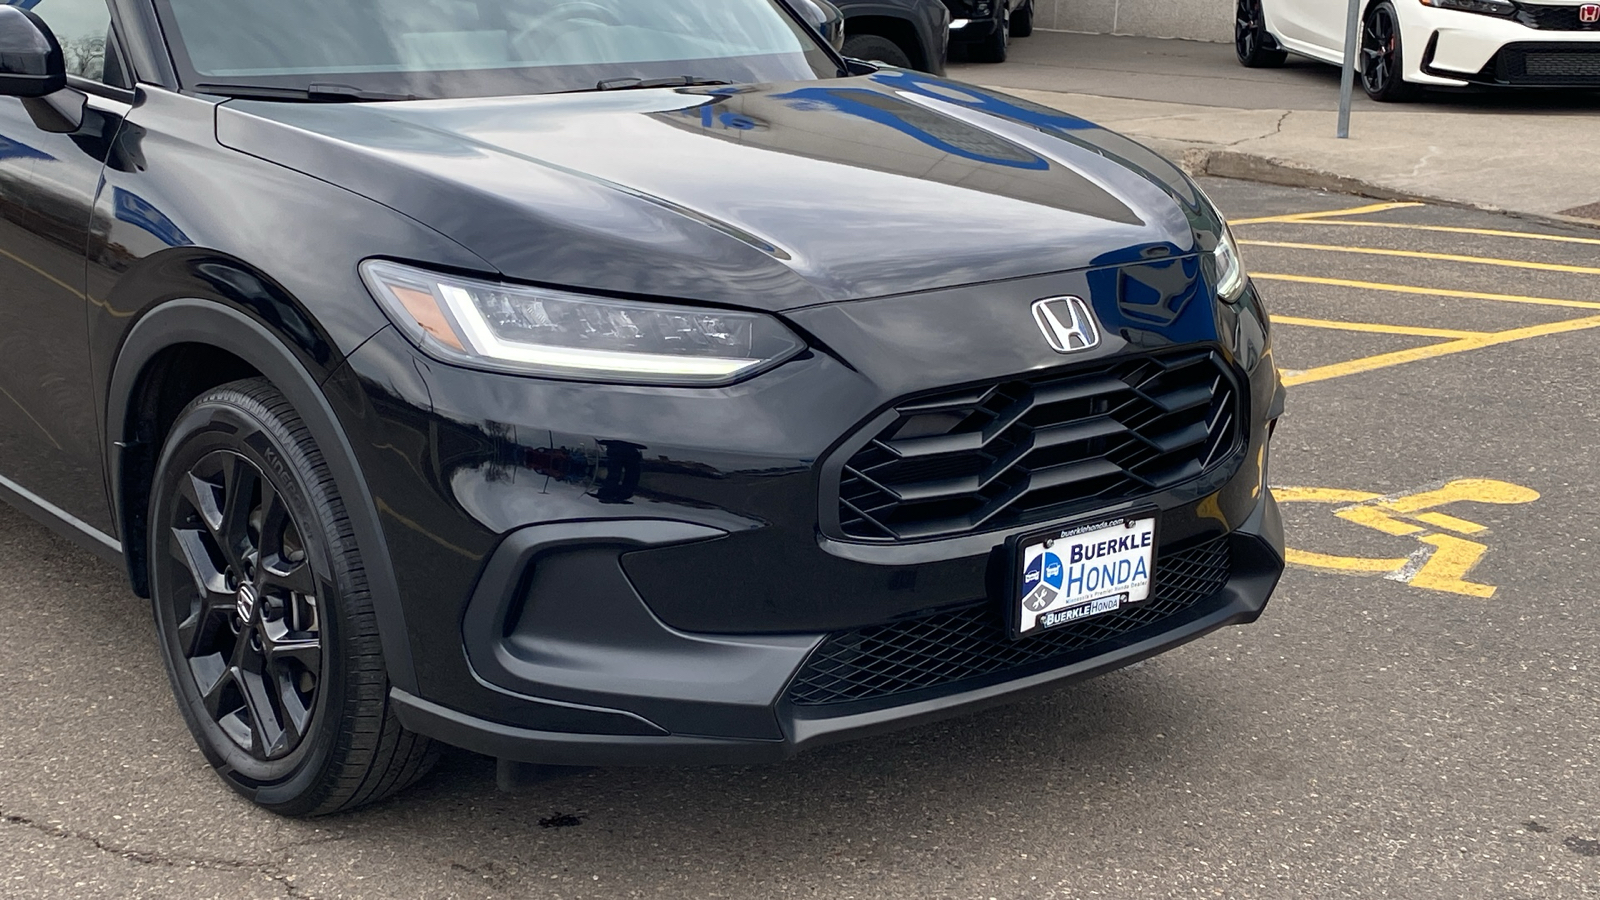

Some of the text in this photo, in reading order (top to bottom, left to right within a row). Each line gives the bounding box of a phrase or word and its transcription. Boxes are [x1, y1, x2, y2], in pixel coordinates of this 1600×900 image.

[1060, 518, 1124, 538] buerklehonda.com
[1070, 531, 1152, 564] BUERKLE
[1066, 556, 1148, 598] HONDA
[1046, 599, 1118, 626] BUERKLE HONDA
